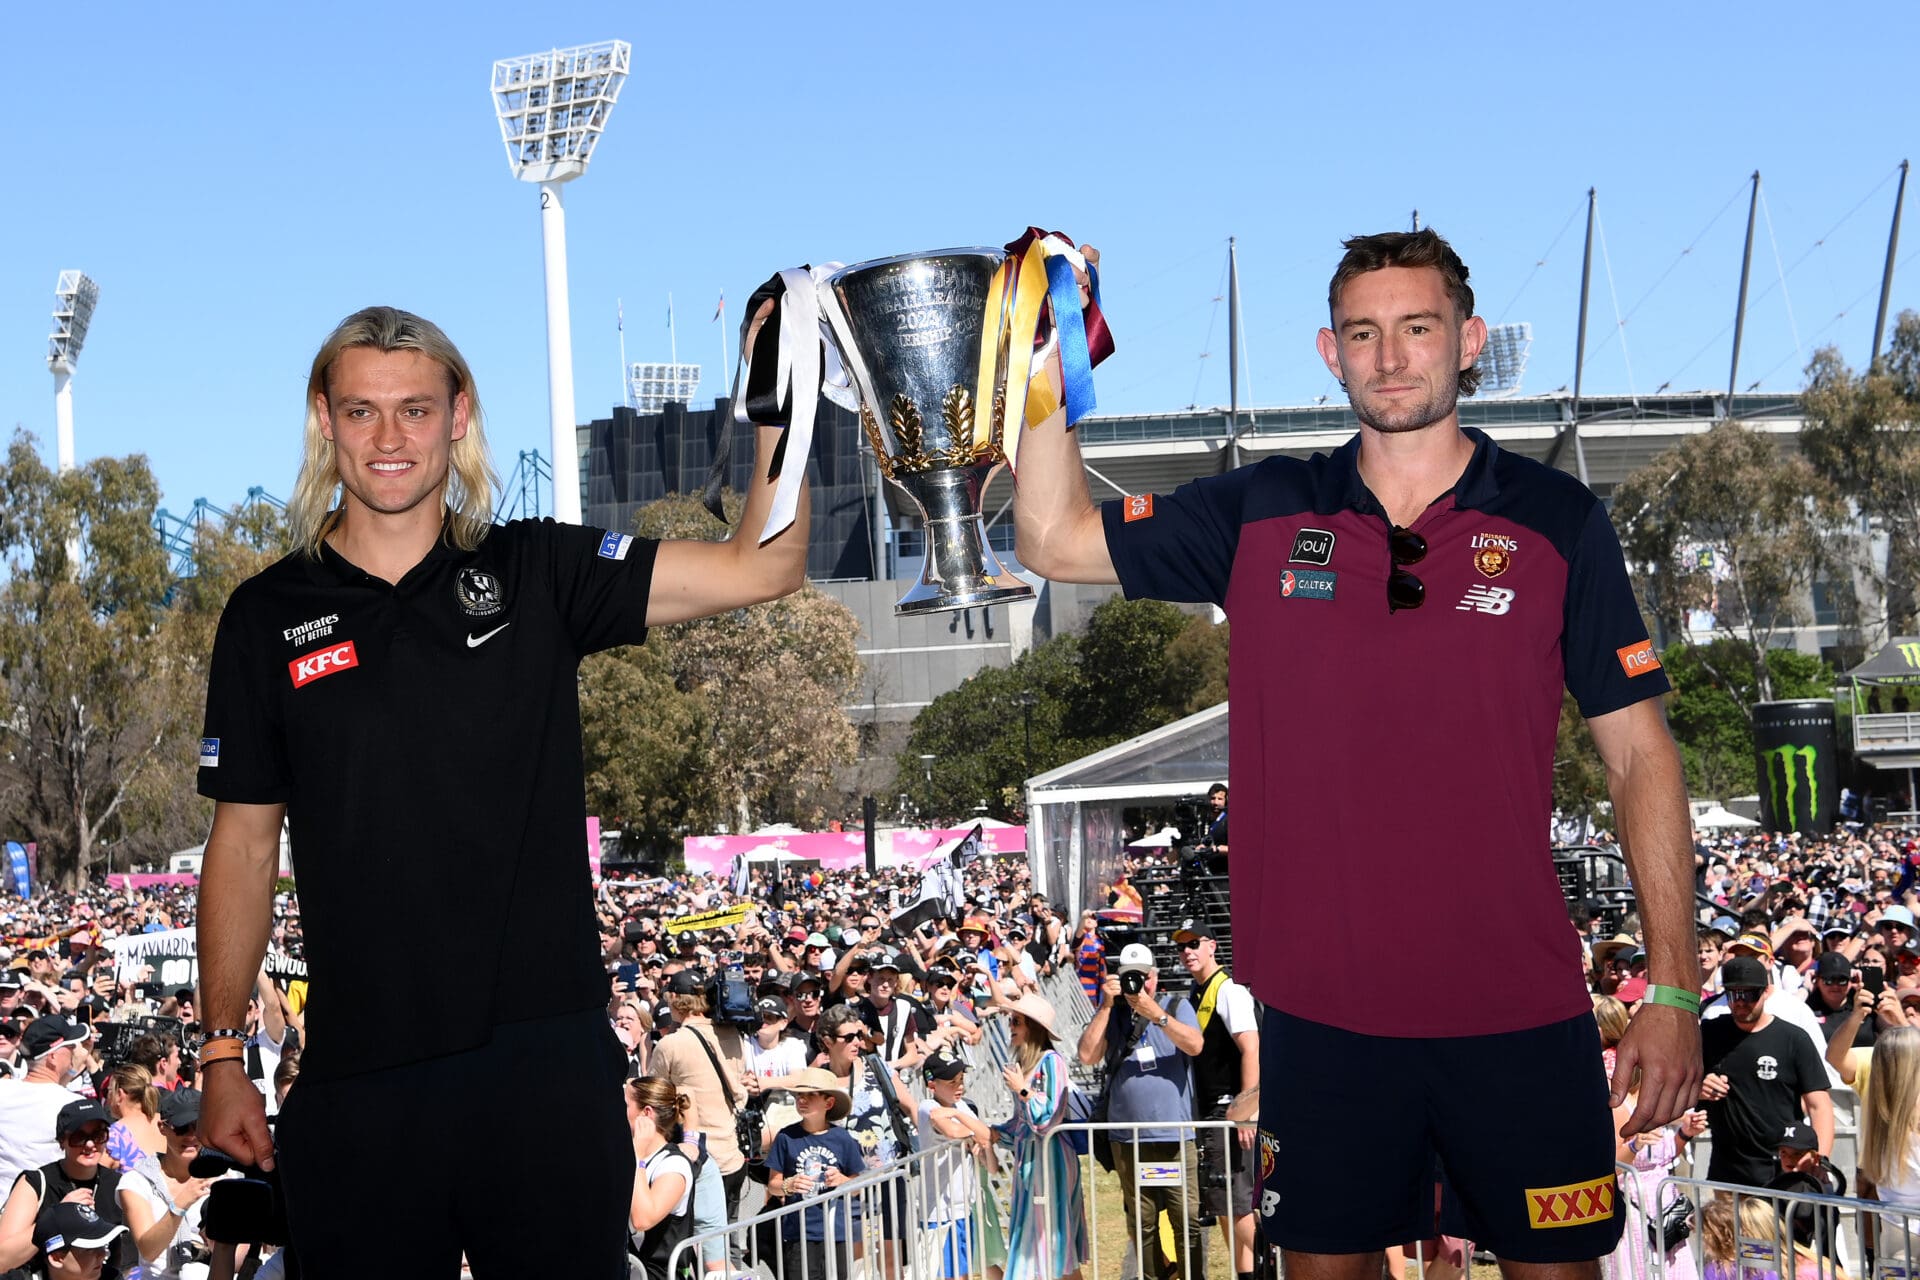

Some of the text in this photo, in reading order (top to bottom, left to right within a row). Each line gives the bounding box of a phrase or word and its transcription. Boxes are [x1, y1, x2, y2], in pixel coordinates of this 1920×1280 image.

[540, 192, 551, 210] 2
[1294, 537, 1329, 557] youi
[1470, 535, 1519, 552] LIONS
[1298, 579, 1334, 592] CALTEX
[282, 613, 340, 642] Emirates
[294, 625, 334, 648] FLY BETTER
[296, 646, 352, 682] KFC
[127, 937, 190, 967] MAYNARD
[1260, 1134, 1281, 1153] ONS
